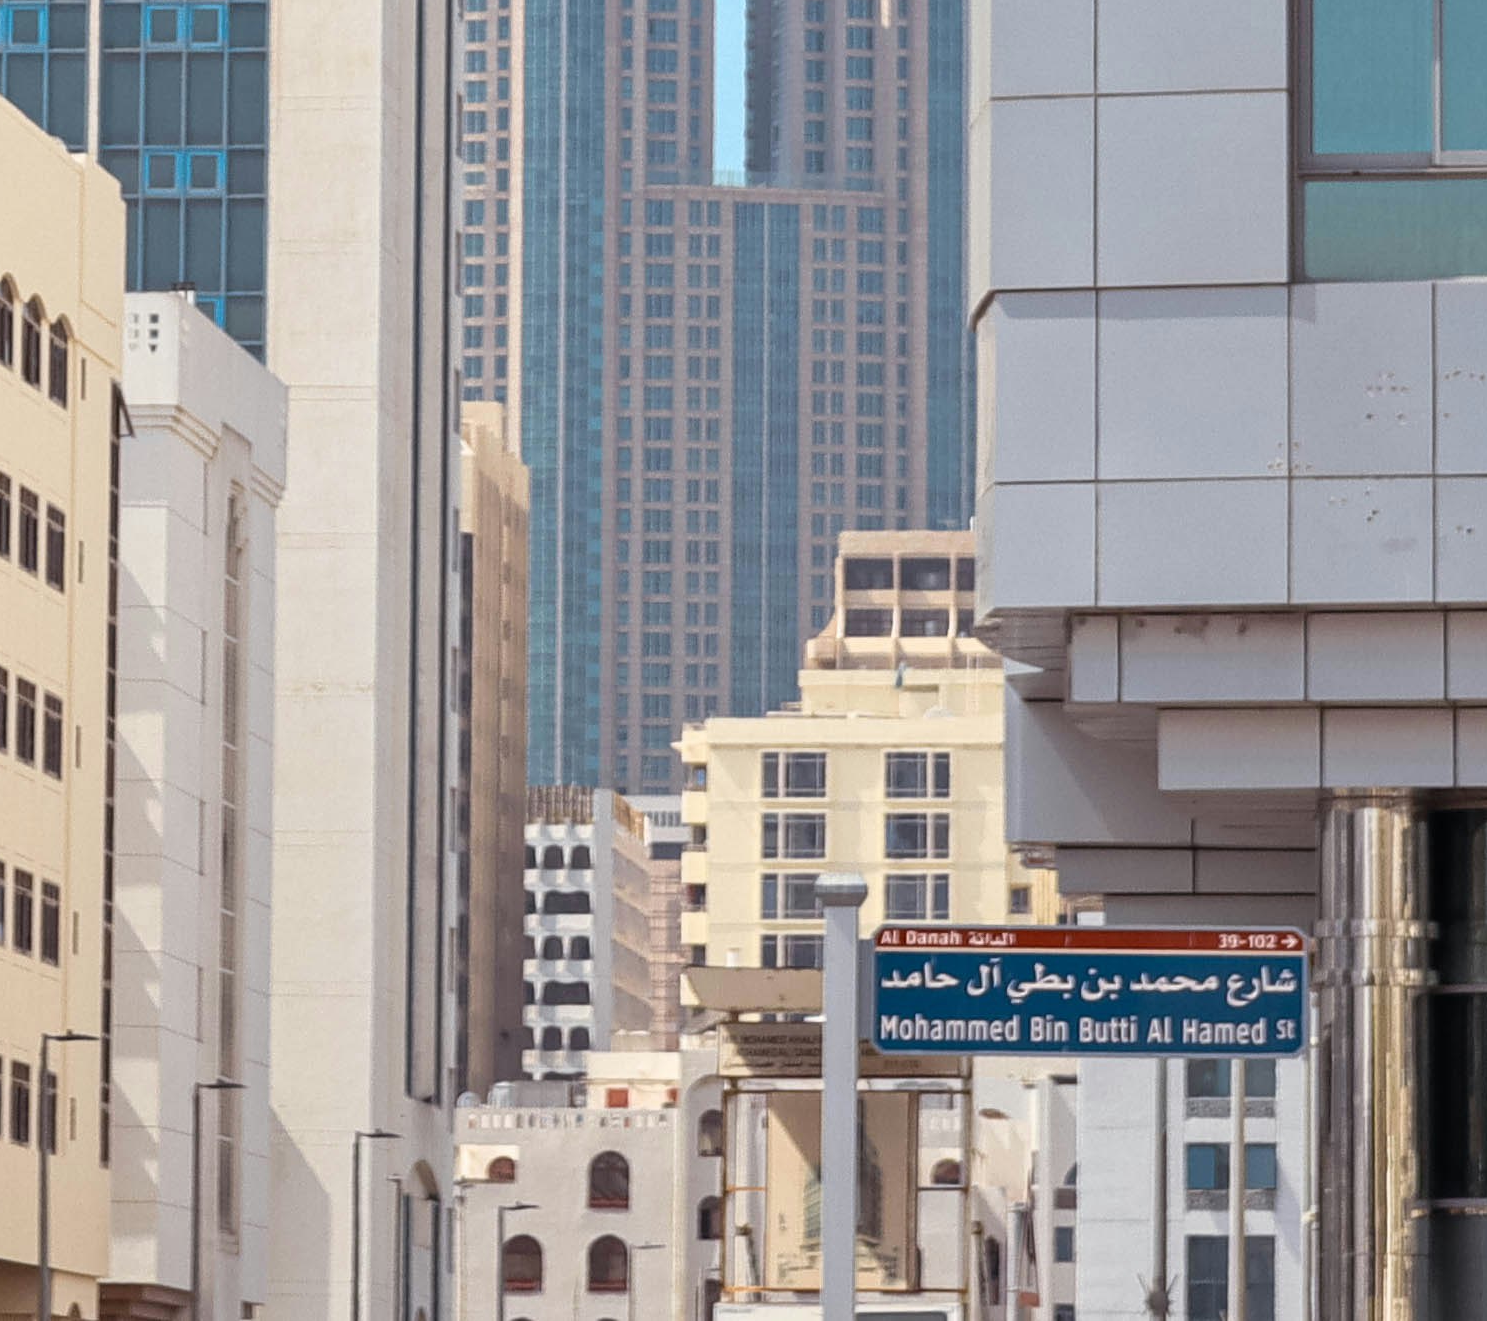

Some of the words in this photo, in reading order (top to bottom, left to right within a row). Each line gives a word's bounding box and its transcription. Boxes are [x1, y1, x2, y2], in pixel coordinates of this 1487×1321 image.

[880, 930, 900, 945] Al
[905, 930, 962, 945] Danah
[1218, 933, 1278, 949] 39-102
[880, 961, 960, 989] حامد
[966, 957, 1002, 996] آل
[1006, 962, 1076, 1004] بطي
[1080, 967, 1123, 1001] بن
[1129, 972, 1221, 992] محمد
[1226, 965, 1298, 1007] شارع
[880, 1013, 1020, 1042] Mohammed
[1030, 1014, 1069, 1042] Bin
[1079, 1015, 1138, 1044] Butti
[1147, 1016, 1173, 1044] Al
[1182, 1017, 1267, 1045] Hamed
[1276, 1019, 1297, 1039] St
